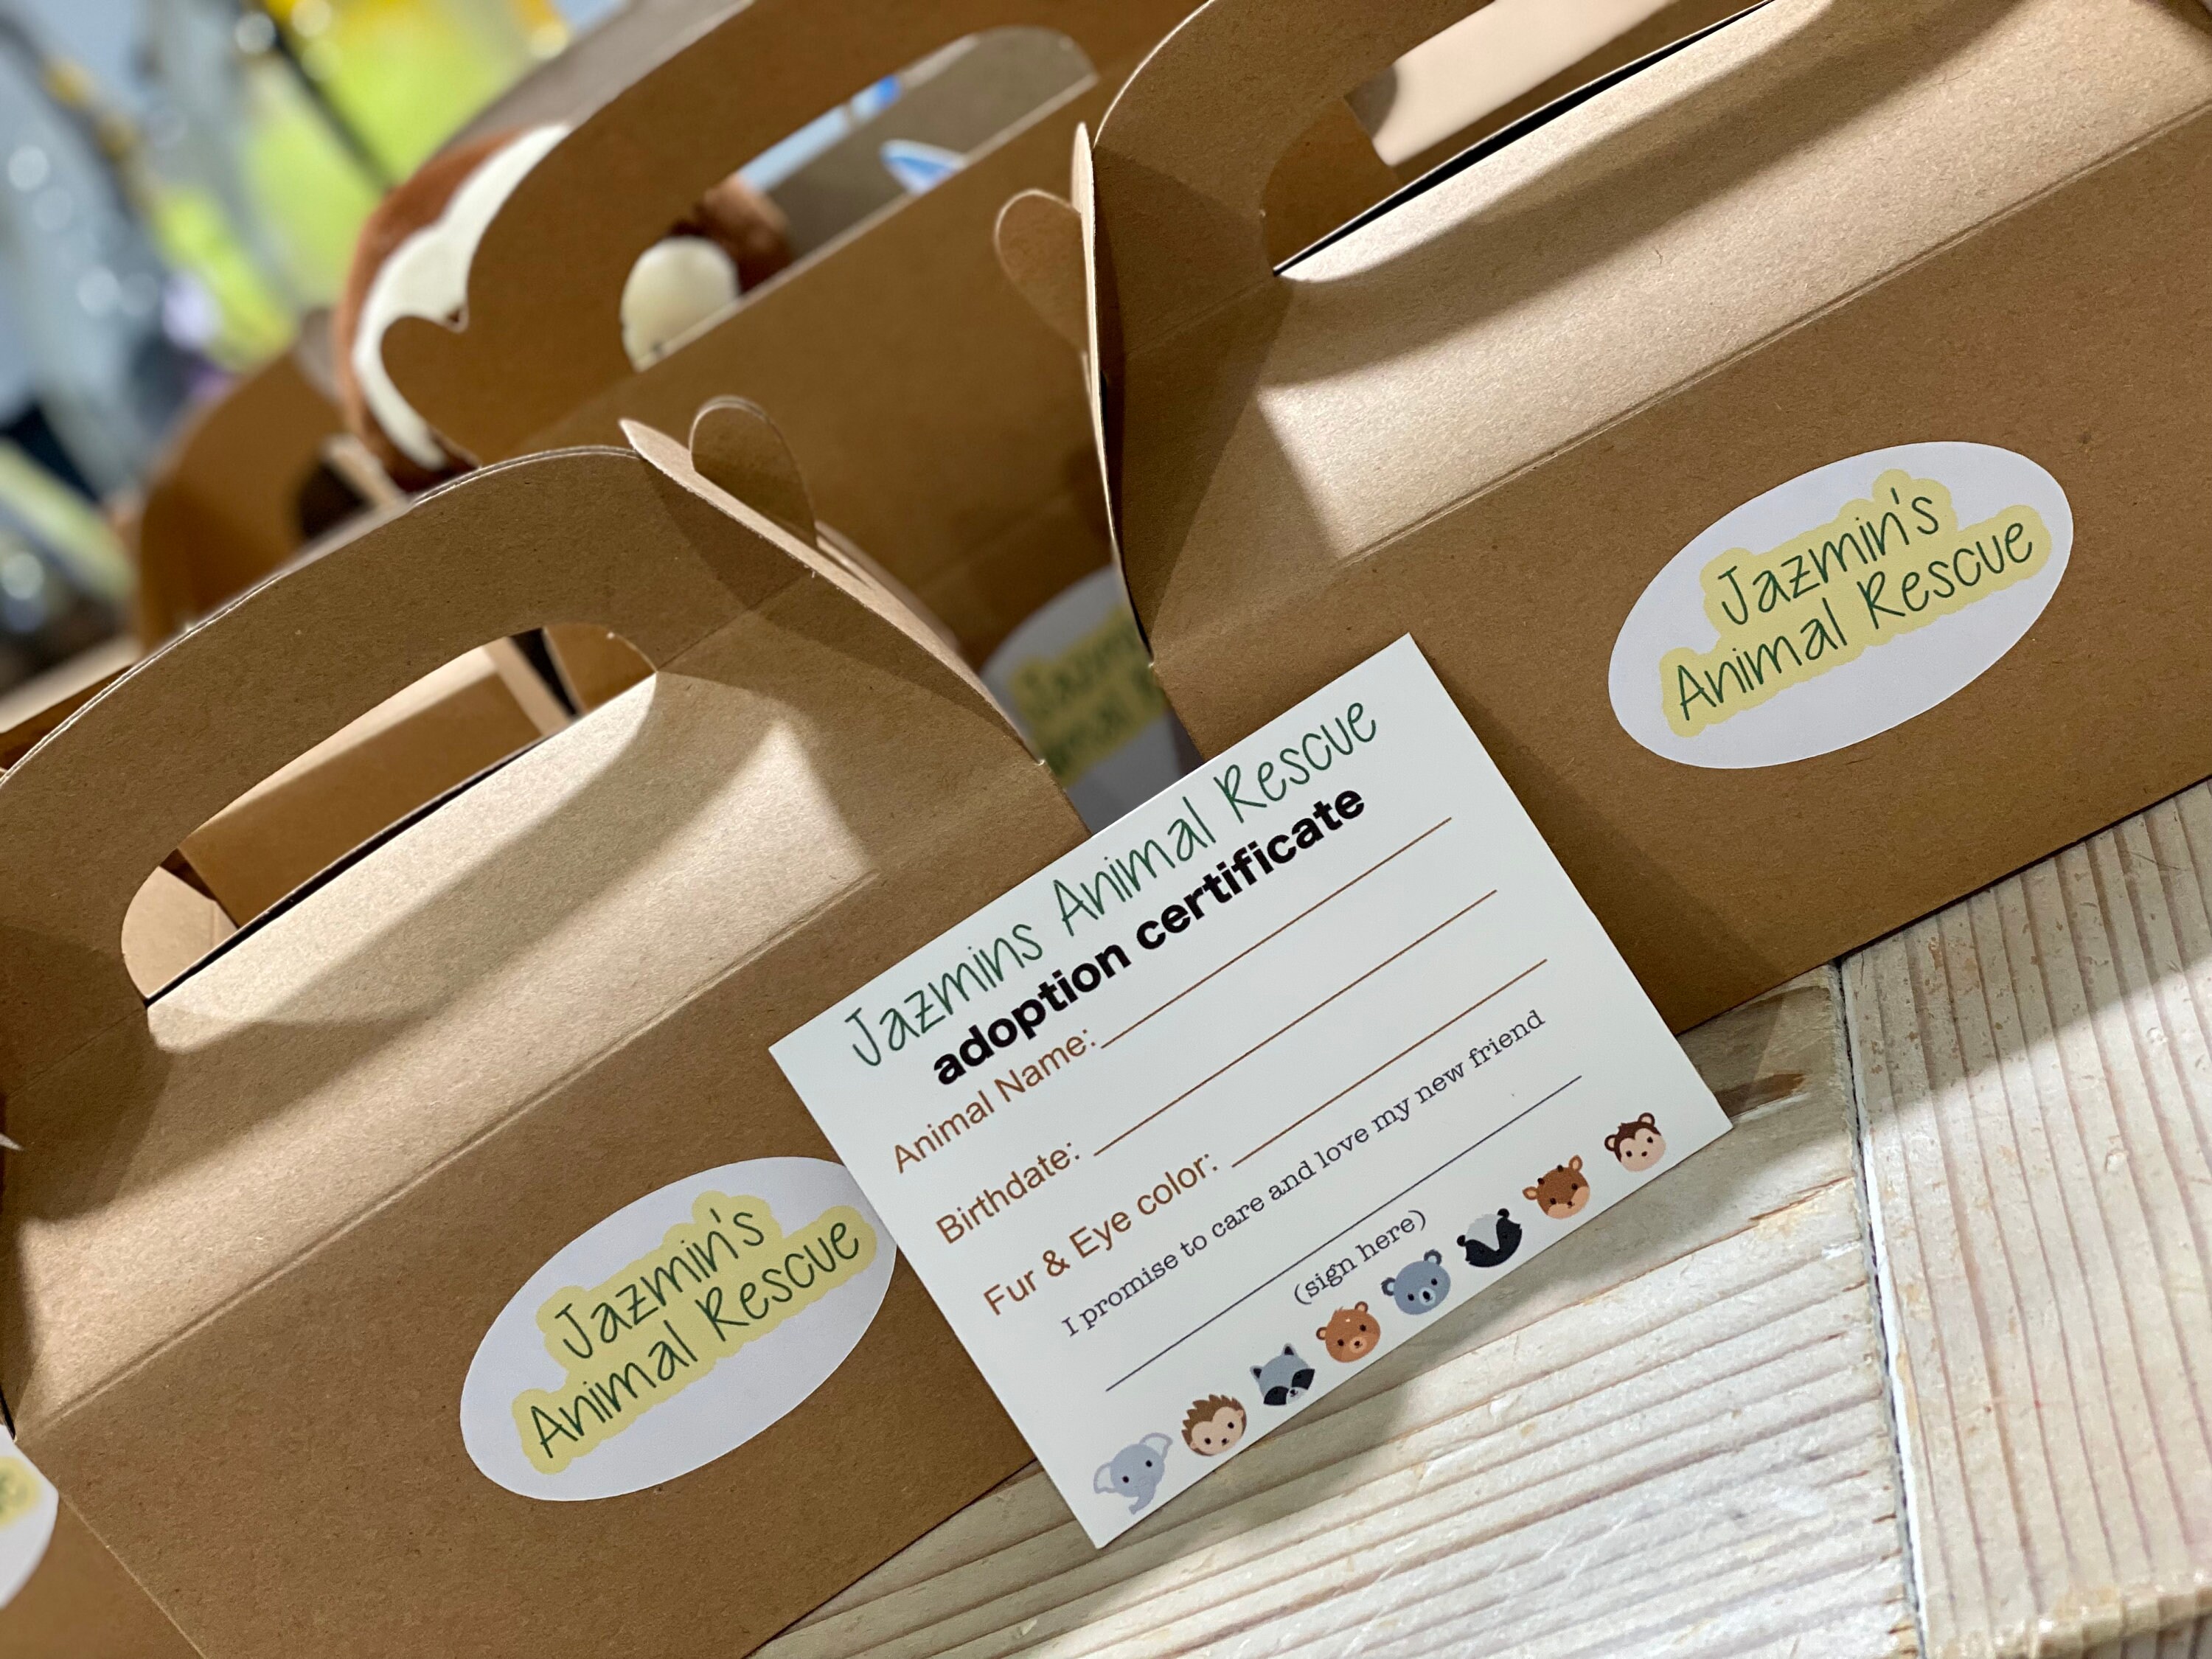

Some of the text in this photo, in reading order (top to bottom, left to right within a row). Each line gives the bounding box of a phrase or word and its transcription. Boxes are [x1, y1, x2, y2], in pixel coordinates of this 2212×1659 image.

[1677, 523, 2033, 720] Animal Rescue
[1718, 487, 1940, 625] Jazmin's
[844, 703, 1377, 1067] Jazmins Animal Rescue
[933, 790, 1365, 1086] adoption certificate
[894, 1030, 1096, 1175] Animal Name:
[1062, 1009, 1546, 1338] I promise to care and love my new friend
[936, 1143, 1080, 1245] Birthdate:
[984, 1155, 1219, 1316] Fur & Eye color:
[1294, 1210, 1427, 1306] (sign here)
[530, 1222, 860, 1458] Animal Rescue
[554, 1208, 765, 1360] Jazmin's
